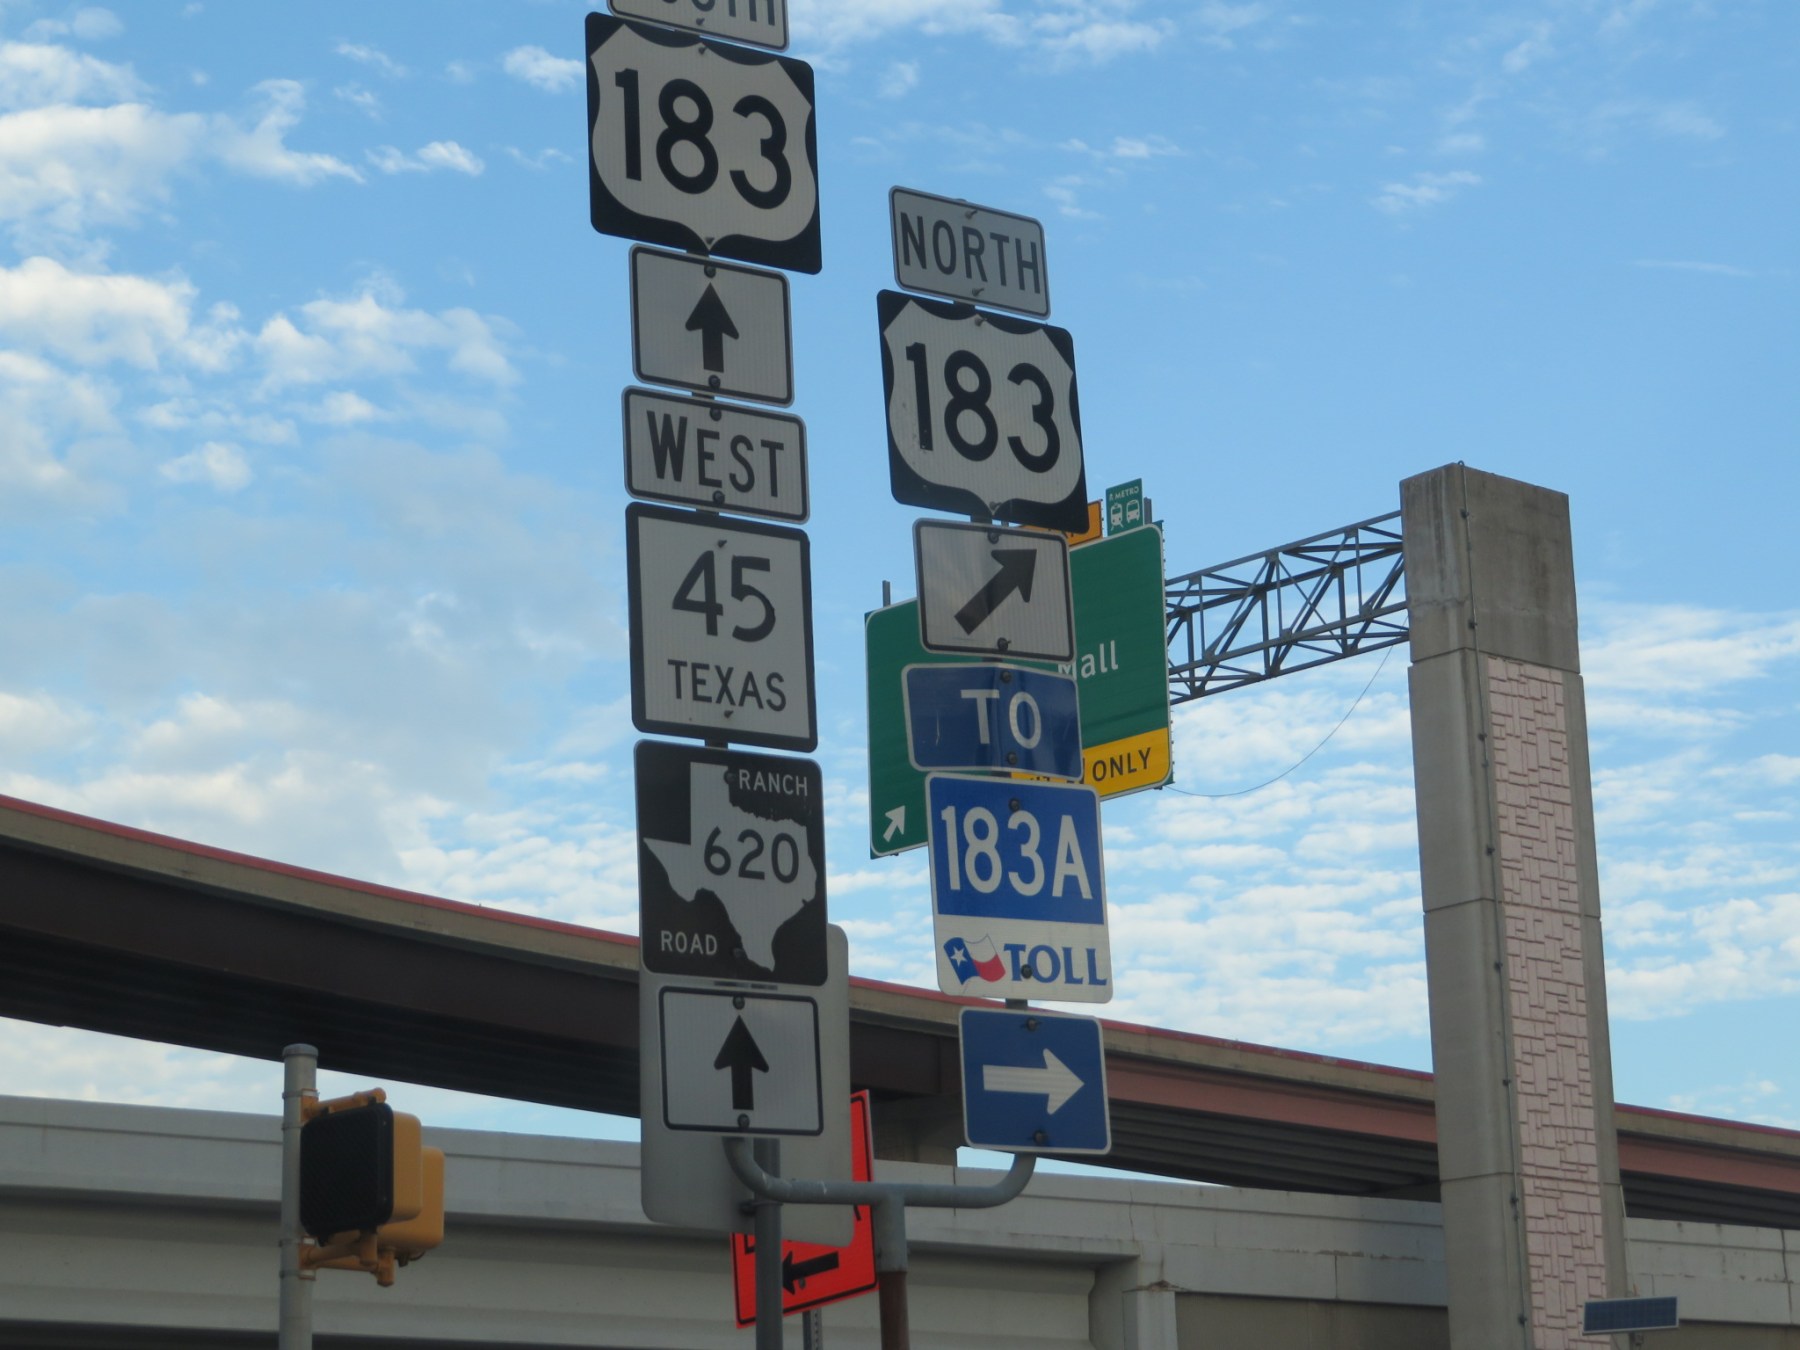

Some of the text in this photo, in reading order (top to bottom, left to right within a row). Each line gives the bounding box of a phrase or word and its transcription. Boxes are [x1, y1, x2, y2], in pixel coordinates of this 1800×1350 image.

[615, 68, 791, 209] 183
[901, 212, 1040, 294] NORTH
[906, 342, 1060, 473] 183
[646, 410, 784, 497] WEST
[672, 550, 776, 642] 45
[667, 659, 787, 712] TEXAS
[961, 689, 1042, 749] TO
[739, 769, 808, 797] RANCH
[1092, 747, 1151, 782] ONLY
[704, 826, 799, 884] 620
[941, 805, 1093, 900] 183A
[661, 930, 718, 956] ROAD
[1003, 943, 1107, 986] TOLL
